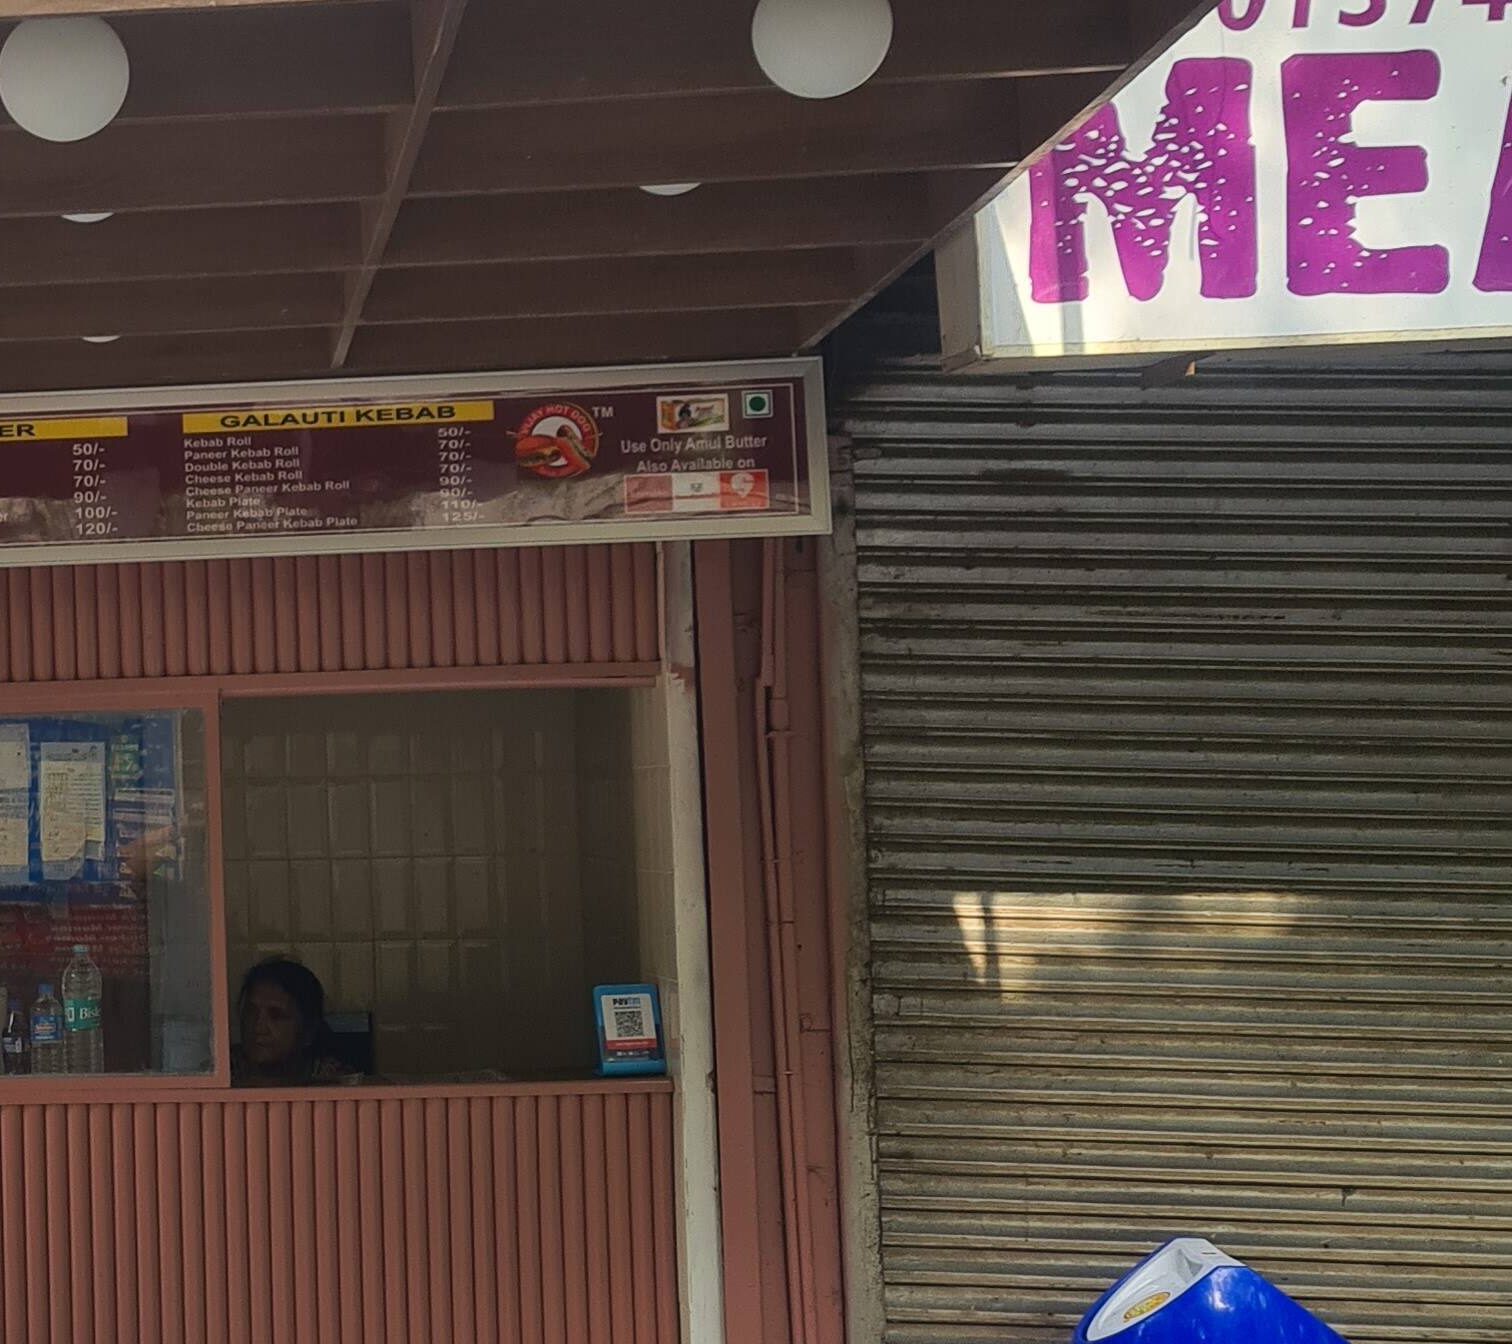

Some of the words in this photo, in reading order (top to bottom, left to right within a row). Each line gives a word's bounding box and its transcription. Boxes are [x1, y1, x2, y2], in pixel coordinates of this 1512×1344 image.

[220, 410, 346, 428] GALAUTI
[355, 406, 456, 422] KEBAB
[592, 406, 613, 418] TM
[184, 437, 223, 448] Kebab
[227, 436, 251, 446] Roll
[438, 427, 471, 437] 50/-
[621, 439, 647, 453] Use
[651, 438, 682, 454] Only
[686, 436, 721, 450] Amul
[725, 435, 767, 449] Butter
[72, 442, 105, 456] 50/-
[231, 448, 271, 458] Kebab
[274, 447, 299, 456] Roll
[438, 439, 471, 449] 70/-
[72, 458, 106, 471] 70/-
[185, 462, 228, 472] Double
[232, 460, 272, 470] Kebab
[275, 458, 300, 468] Roll
[439, 451, 472, 461] 70/-
[637, 459, 667, 473] Also
[671, 457, 734, 472] Available
[738, 457, 756, 468] on
[73, 474, 107, 488] 70/-
[185, 474, 230, 484] Cheese
[234, 472, 275, 482] Kebab
[278, 470, 303, 480] Roll
[440, 463, 472, 473] 70/-
[186, 486, 231, 497] Cheese
[235, 484, 278, 494] Paneer
[281, 482, 321, 492] Kebab
[325, 480, 350, 490] Roll
[439, 475, 472, 486] 90/-
[73, 490, 107, 504] 90/-
[186, 498, 225, 508] Kebab
[229, 496, 261, 506] Plate
[440, 487, 473, 497] 90/-
[75, 506, 118, 519] 100/-
[233, 508, 273, 518] Kebab
[276, 506, 308, 516] Plate
[76, 522, 119, 535] 120/-
[187, 522, 233, 532] Cheese
[283, 518, 323, 528] Kebab
[326, 515, 358, 526] Plate
